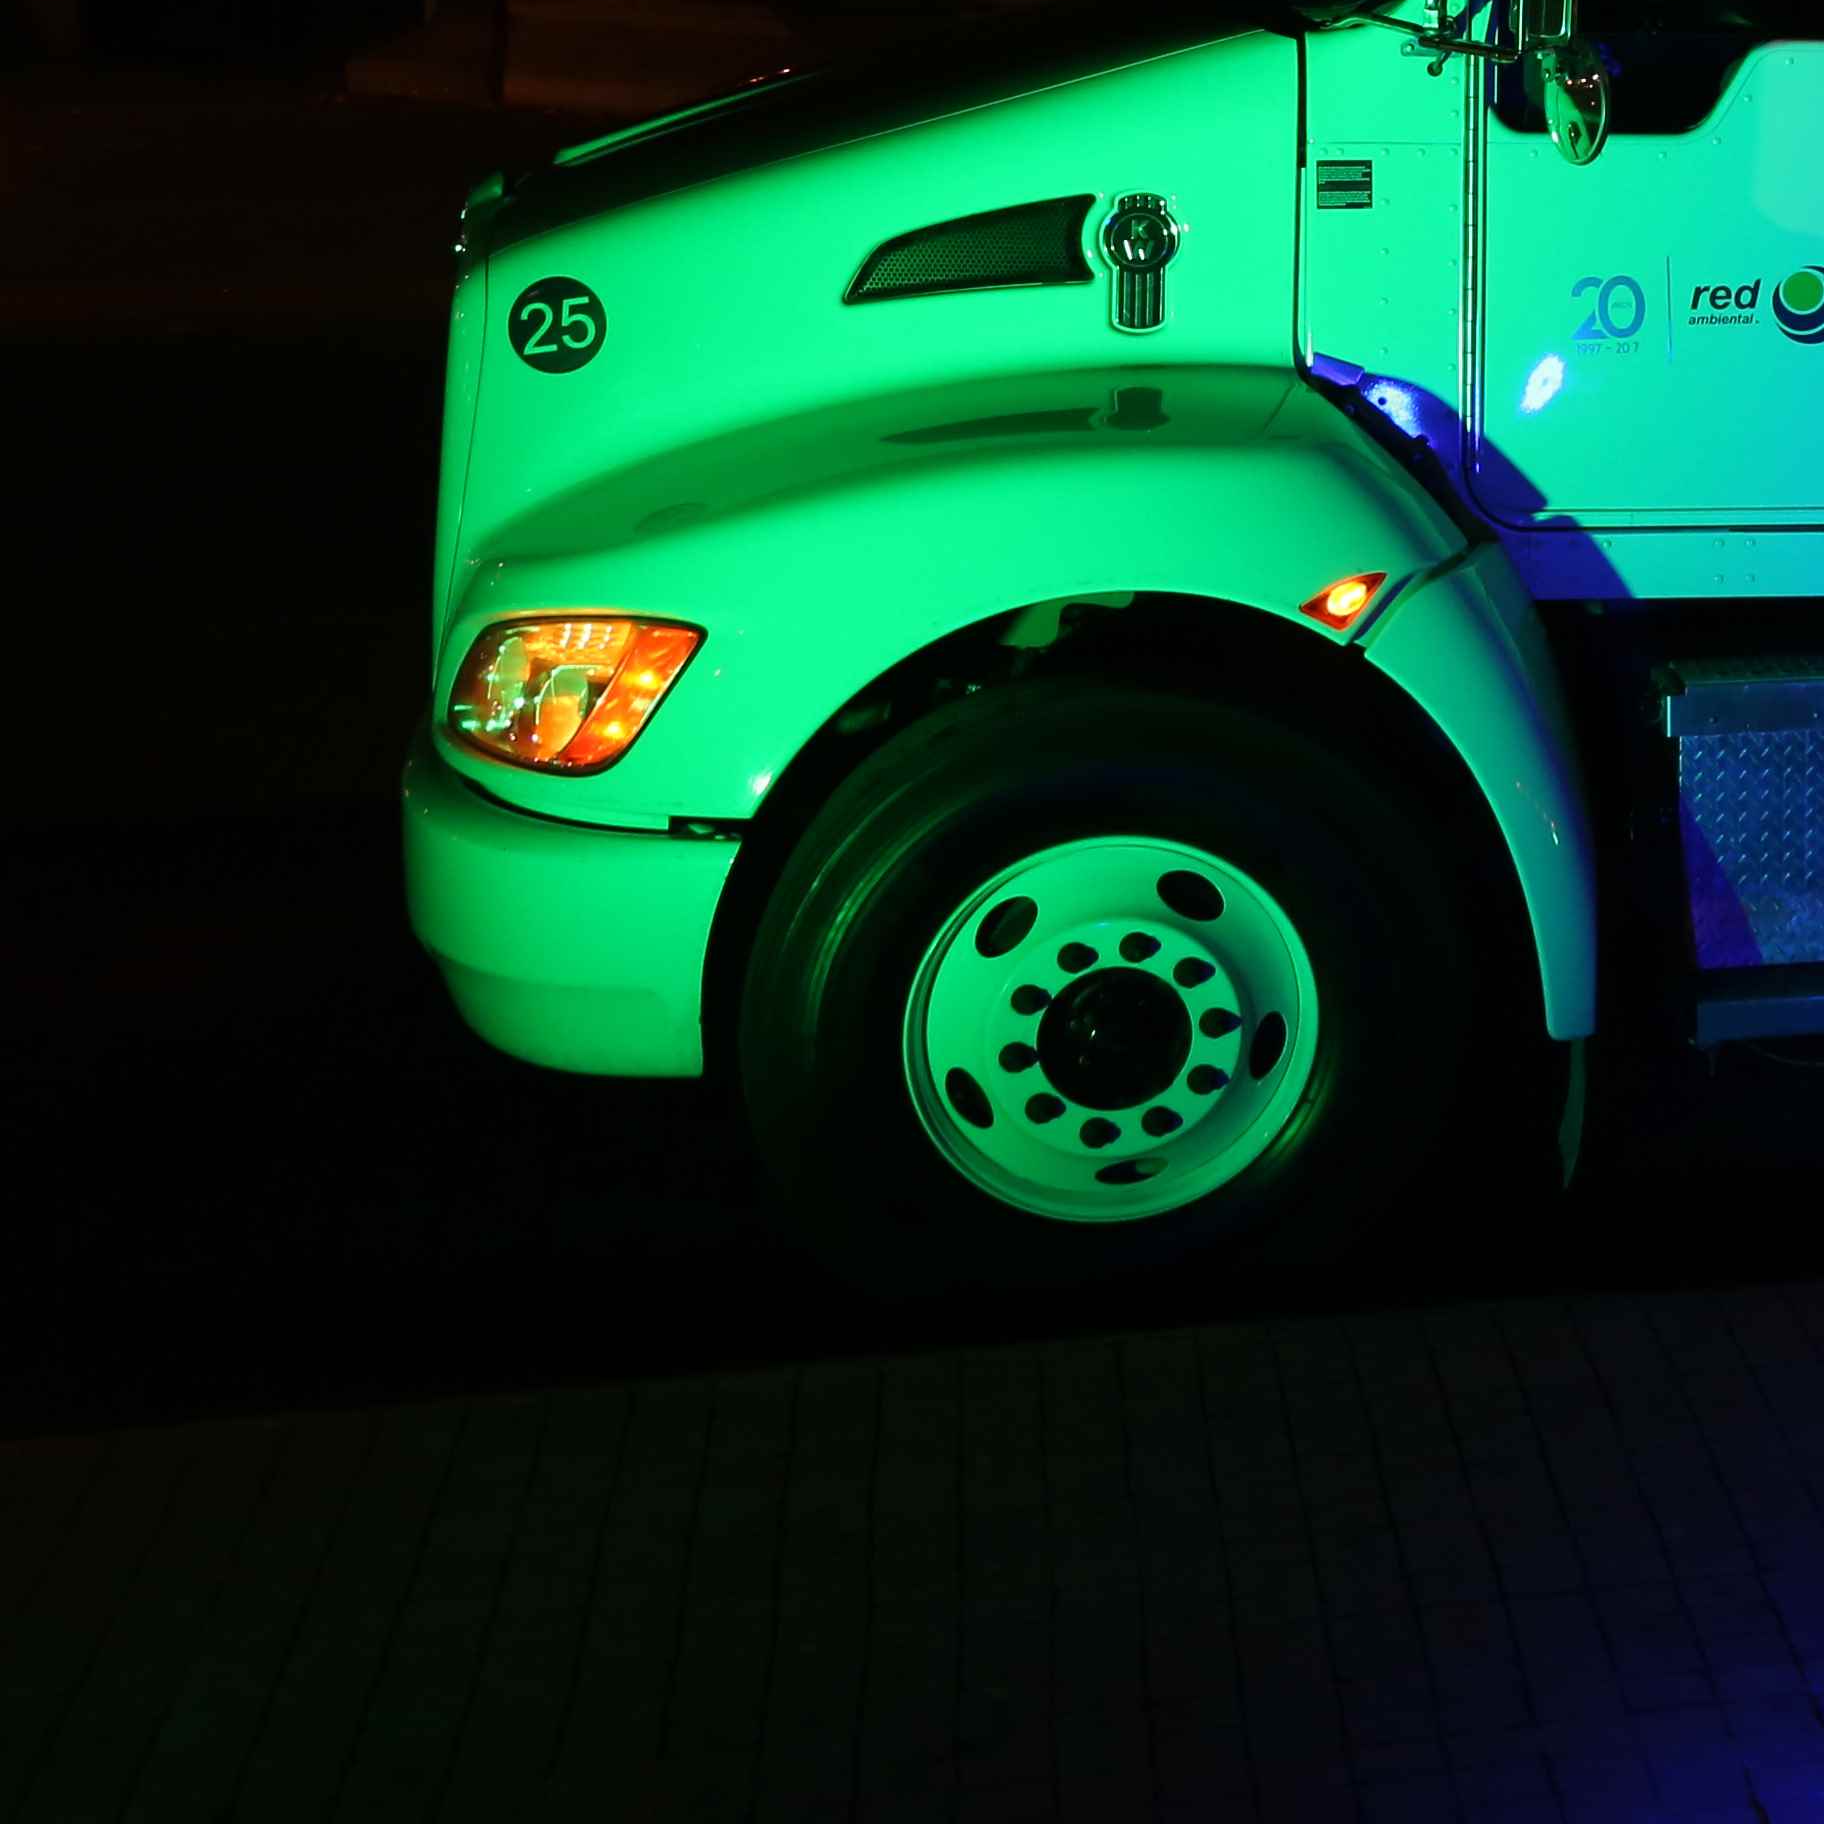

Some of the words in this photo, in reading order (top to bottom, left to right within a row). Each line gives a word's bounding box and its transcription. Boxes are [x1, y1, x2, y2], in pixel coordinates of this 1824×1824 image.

[1571, 275, 1646, 339] 20
[1690, 278, 1761, 310] red
[520, 297, 596, 355] 25
